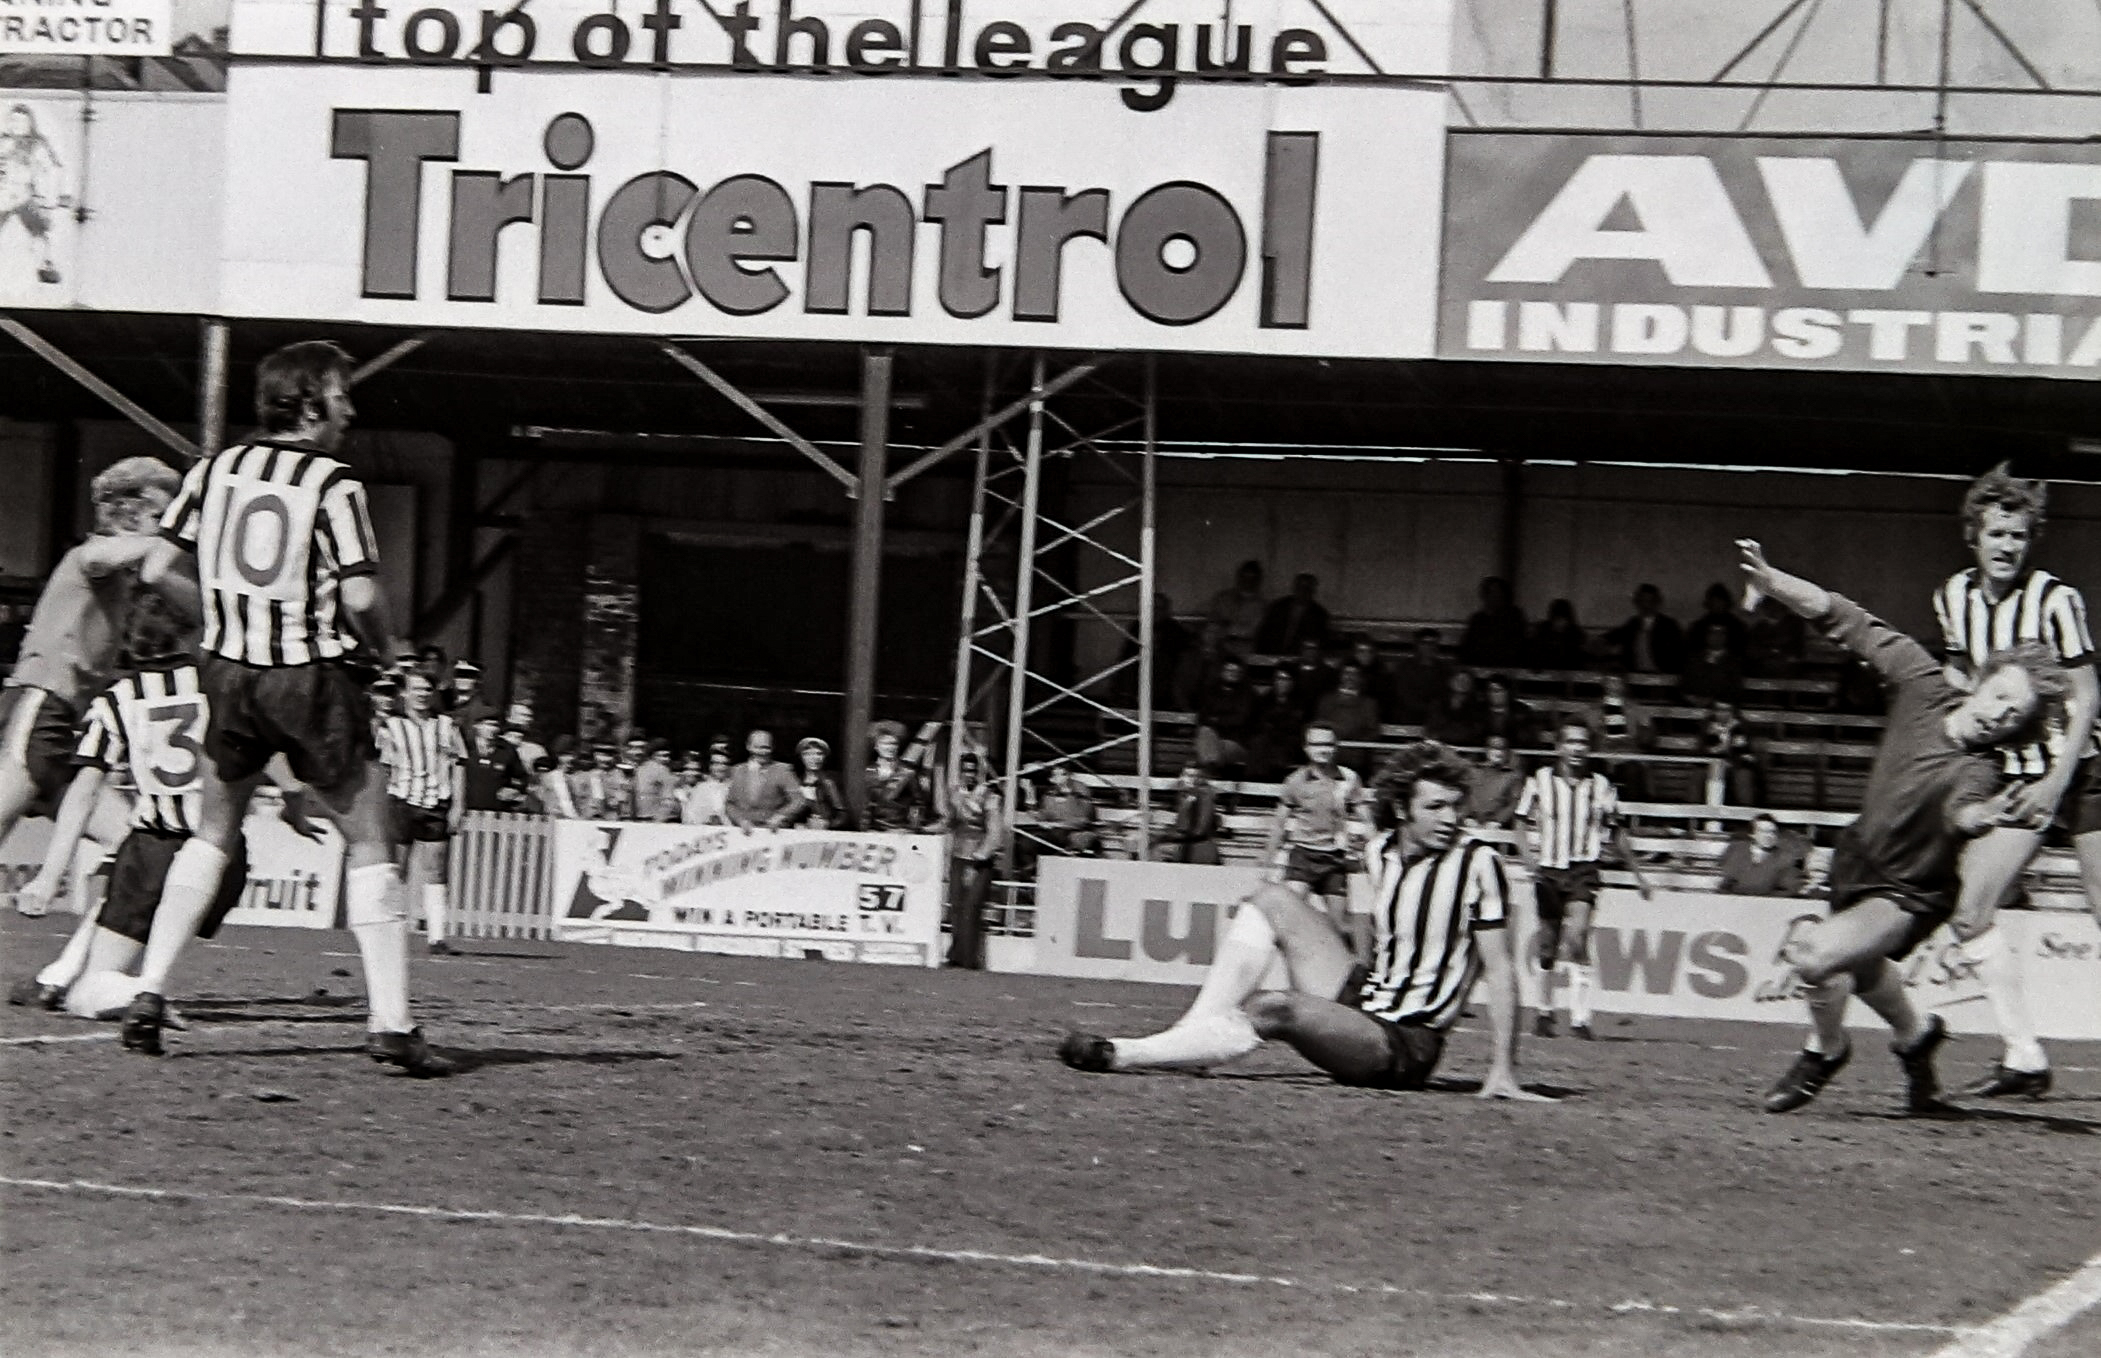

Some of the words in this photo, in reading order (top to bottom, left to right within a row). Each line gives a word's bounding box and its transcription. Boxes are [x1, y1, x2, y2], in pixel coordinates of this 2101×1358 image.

[0, 15, 154, 43] RACTOR
[350, 0, 537, 94] top
[572, 0, 681, 72] of
[712, 0, 906, 78] the
[944, 0, 1328, 112] league
[331, 108, 1320, 329] Tricentrol
[148, 702, 205, 788] 3
[239, 868, 320, 911] ruit
